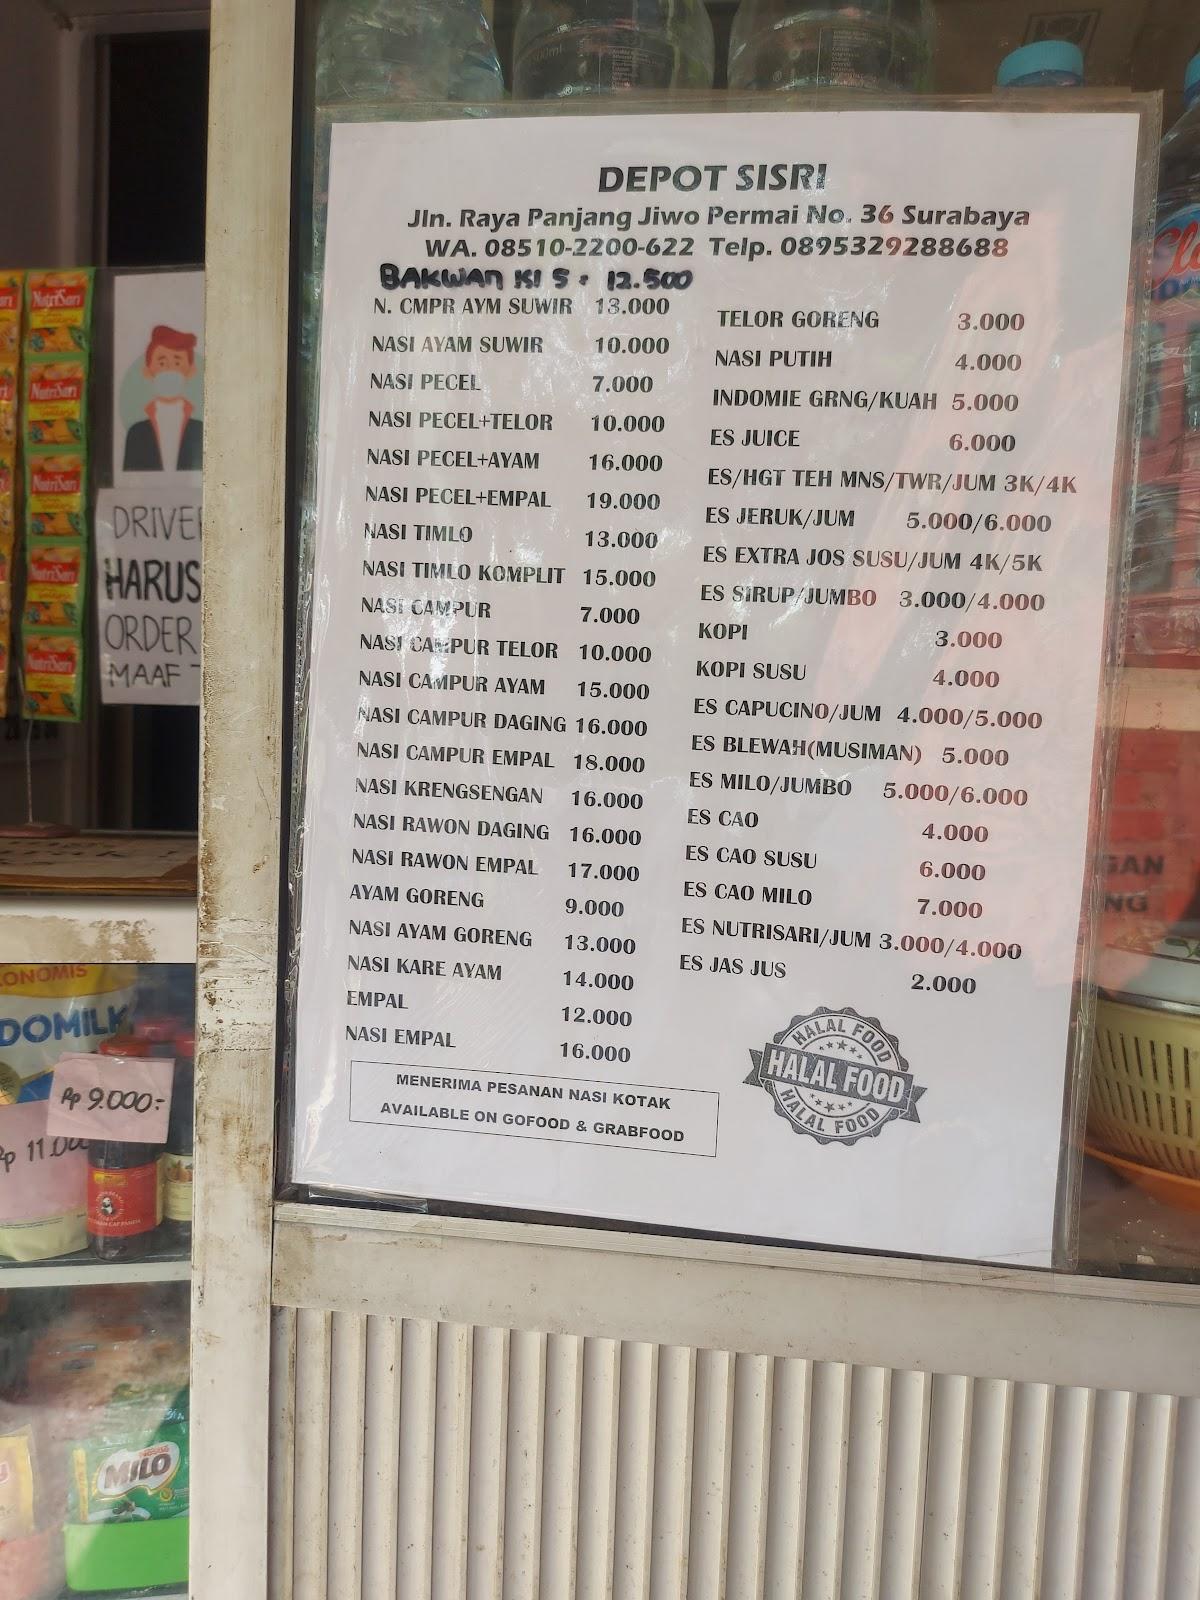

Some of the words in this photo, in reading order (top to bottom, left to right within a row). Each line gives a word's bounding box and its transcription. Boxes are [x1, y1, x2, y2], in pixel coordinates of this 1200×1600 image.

[599, 166, 728, 192] DEPOT
[736, 164, 827, 191] SISRI
[408, 209, 451, 228] Jln.
[460, 209, 520, 232] Raya
[528, 208, 631, 231] Panjang
[638, 207, 699, 225] Jiwo
[708, 206, 798, 225] Permai
[807, 205, 852, 223] No.
[861, 204, 894, 223] 36
[902, 205, 1030, 231] Surabaya
[426, 239, 477, 258] WA.
[485, 238, 694, 257] 08510-2200-622
[710, 238, 772, 261] Telp.
[780, 237, 1008, 257] 0895329288688
[607, 269, 693, 290] 12.500
[374, 298, 391, 314] N.
[400, 298, 455, 314] CMPR
[462, 298, 501, 314] AYM
[509, 298, 572, 314] SUWIR
[596, 298, 669, 314] 13.000
[717, 311, 784, 328] TELOR
[792, 311, 879, 328] GORENG
[958, 313, 1025, 331] 3.000
[372, 336, 414, 352] NASI
[421, 336, 472, 352] AYAM
[479, 336, 543, 353] SUWIR
[596, 338, 669, 354] 10.000
[715, 350, 761, 367] NASI
[769, 351, 832, 368] PUTIH
[955, 354, 1022, 371] 4.000
[713, 389, 801, 407] INDOMIE
[809, 391, 937, 412] GRNG/KUAH
[952, 393, 1019, 412] 5.000
[369, 411, 411, 428] NASI
[419, 412, 553, 431] PECEL+TELOR
[591, 416, 665, 432] 10.000
[710, 429, 734, 446] ES
[741, 430, 800, 447] JUICE
[949, 434, 1015, 452] 6.000
[367, 449, 409, 466] NASI
[418, 450, 539, 469] PECEL+AYAM
[589, 454, 662, 472] 16.000
[708, 469, 786, 488] ES/HGT
[792, 470, 832, 486] TEH
[840, 471, 996, 493] MNS/TWR/JUM
[1004, 475, 1077, 496] 3K/4K
[365, 486, 408, 503] NASI
[416, 488, 551, 508] PECEL+EMPAL
[587, 492, 661, 510] 19.000
[705, 507, 730, 524] ES
[736, 508, 855, 529] JERUK/JUM
[906, 512, 1051, 534] 5.000/6.000
[364, 524, 406, 540] NASI
[414, 524, 473, 542] TIMLO
[586, 531, 658, 549] 13.000
[363, 561, 405, 578] NASI
[412, 562, 471, 580] TIMLO
[478, 564, 566, 584] KOMPLIT
[583, 569, 656, 587] 15.000
[703, 546, 727, 563] ES
[735, 547, 799, 565] EXTRA
[806, 548, 845, 566] JOS
[852, 550, 961, 571] SUSU/JUM
[970, 552, 1043, 575] 4K/5K
[105, 557, 202, 604] HARUS
[105, 613, 198, 656] ORDER
[109, 662, 181, 688] MAAF
[696, 661, 745, 678] KOPI
[753, 663, 806, 680] SUSU
[932, 670, 999, 688] 4.000
[358, 707, 400, 724] NASI
[407, 709, 486, 728] CAMPUR
[494, 712, 566, 732] DAGING
[576, 718, 648, 736] 16.000
[694, 698, 717, 715] ES
[725, 700, 881, 722] CAPUCINO/JUM
[897, 707, 1043, 730] 4.000/5.000
[357, 742, 399, 759] NASI
[406, 744, 484, 764] CAMPUR
[492, 749, 555, 768] EMPAL
[574, 754, 645, 773] 18.000
[691, 735, 715, 752] ES
[723, 736, 922, 765] BLEWAH(MUSIMAN)
[942, 747, 1009, 766] 5.000
[355, 778, 397, 794] NASI
[404, 780, 543, 804] KRENGSENGAN
[571, 791, 643, 809] 16.000
[689, 772, 713, 789] ES
[721, 773, 852, 796] MILO/JUMBO
[883, 782, 1028, 807] 5.000/6.000
[687, 808, 711, 825] ES
[719, 810, 759, 828] CAO
[922, 823, 988, 843] 4.000
[352, 849, 394, 866] NASI
[401, 852, 468, 871] RAWON
[476, 857, 538, 876] EMPAL
[568, 862, 639, 881] 17.000
[350, 884, 399, 902] AYAM
[406, 887, 484, 908] GORENG
[565, 898, 624, 917] 9.000
[684, 881, 707, 898] ES
[714, 883, 754, 901] CAO
[762, 887, 812, 906] MILO
[917, 899, 983, 918] 7.000
[349, 919, 390, 938] NASI
[397, 923, 446, 941] AYAM
[454, 927, 533, 947] GORENG
[565, 935, 636, 954] 13.000
[682, 918, 705, 935] ES
[712, 920, 871, 949] NUTRISARI/JUM
[879, 934, 1022, 960] 3.000/4.000
[680, 955, 703, 971] ES
[709, 957, 743, 976] JAS
[750, 960, 787, 979] JUS
[911, 974, 976, 994] 2.000
[347, 990, 409, 1009] EMPAL
[562, 1007, 632, 1027] 12.000
[792, 1019, 846, 1045] HALAL
[852, 1023, 892, 1062] FOOD
[767, 1049, 838, 1090] HALAL
[843, 1066, 905, 1103] FOOD
[396, 1074, 482, 1092] MENERIMA
[487, 1082, 563, 1099] PESANAN
[569, 1089, 607, 1103] NASI
[613, 1093, 671, 1110] KOTAK
[381, 1103, 470, 1120] AVAILABLE
[475, 1110, 497, 1123] ON
[502, 1113, 570, 1130] GOFOOD
[576, 1120, 587, 1131] &
[593, 1122, 684, 1142] GRABFOOD
[781, 1088, 824, 1131] HALAL
[835, 1107, 880, 1133] FOOD
[104, 1454, 172, 1488] MILO
